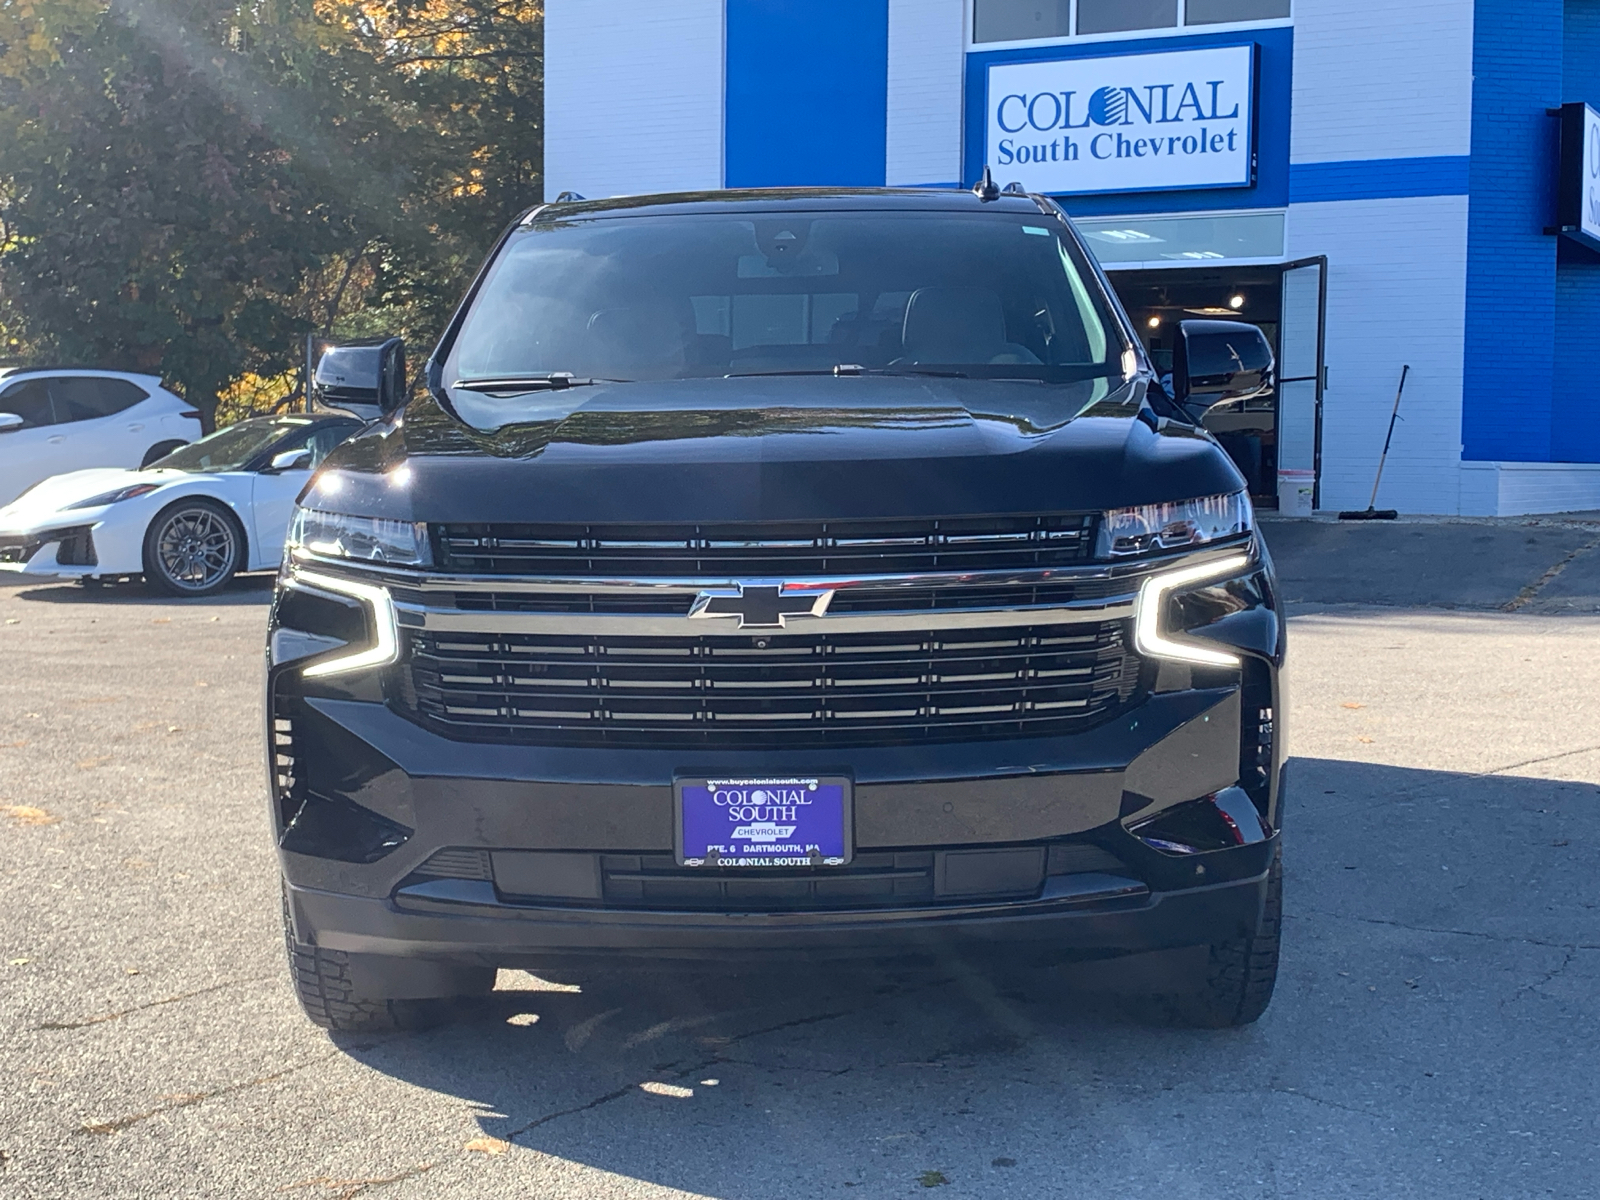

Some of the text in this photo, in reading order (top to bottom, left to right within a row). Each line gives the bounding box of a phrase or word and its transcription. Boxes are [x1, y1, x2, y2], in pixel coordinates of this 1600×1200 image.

[997, 81, 1239, 133] COLONIAL
[998, 127, 1238, 165] South Chevrolet
[707, 778, 818, 787] www.buycolonialsouth.com
[713, 790, 813, 806] COLONIAL
[729, 806, 797, 821] SOUTH
[737, 828, 790, 836] CHEVROLET
[729, 844, 736, 853] 6
[743, 844, 803, 854] DARTMOUTH,
[717, 857, 811, 867] COLONIAL SOUTH
